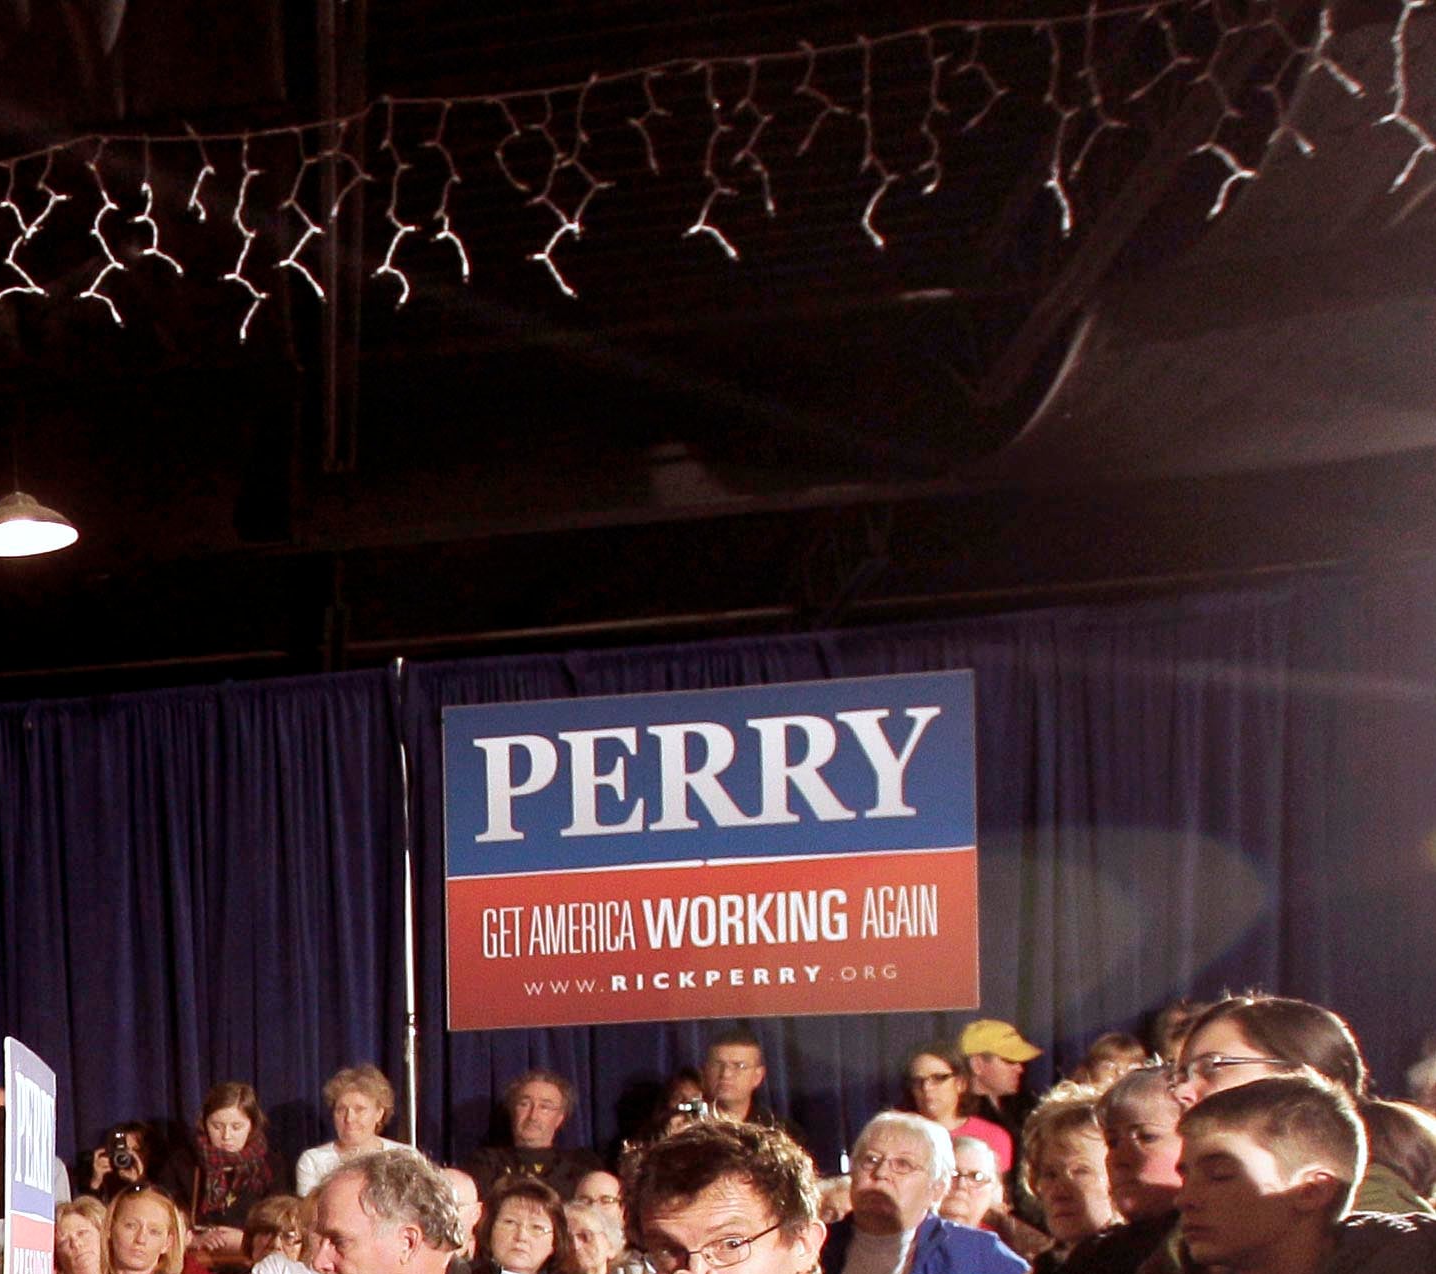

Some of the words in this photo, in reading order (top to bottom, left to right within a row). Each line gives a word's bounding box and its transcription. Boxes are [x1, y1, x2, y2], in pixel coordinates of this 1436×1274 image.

[474, 706, 942, 843] PERRY
[482, 906, 524, 960] GET
[529, 900, 637, 957] AMERICA
[642, 887, 848, 951] WORKING
[860, 884, 939, 940] AGAIN
